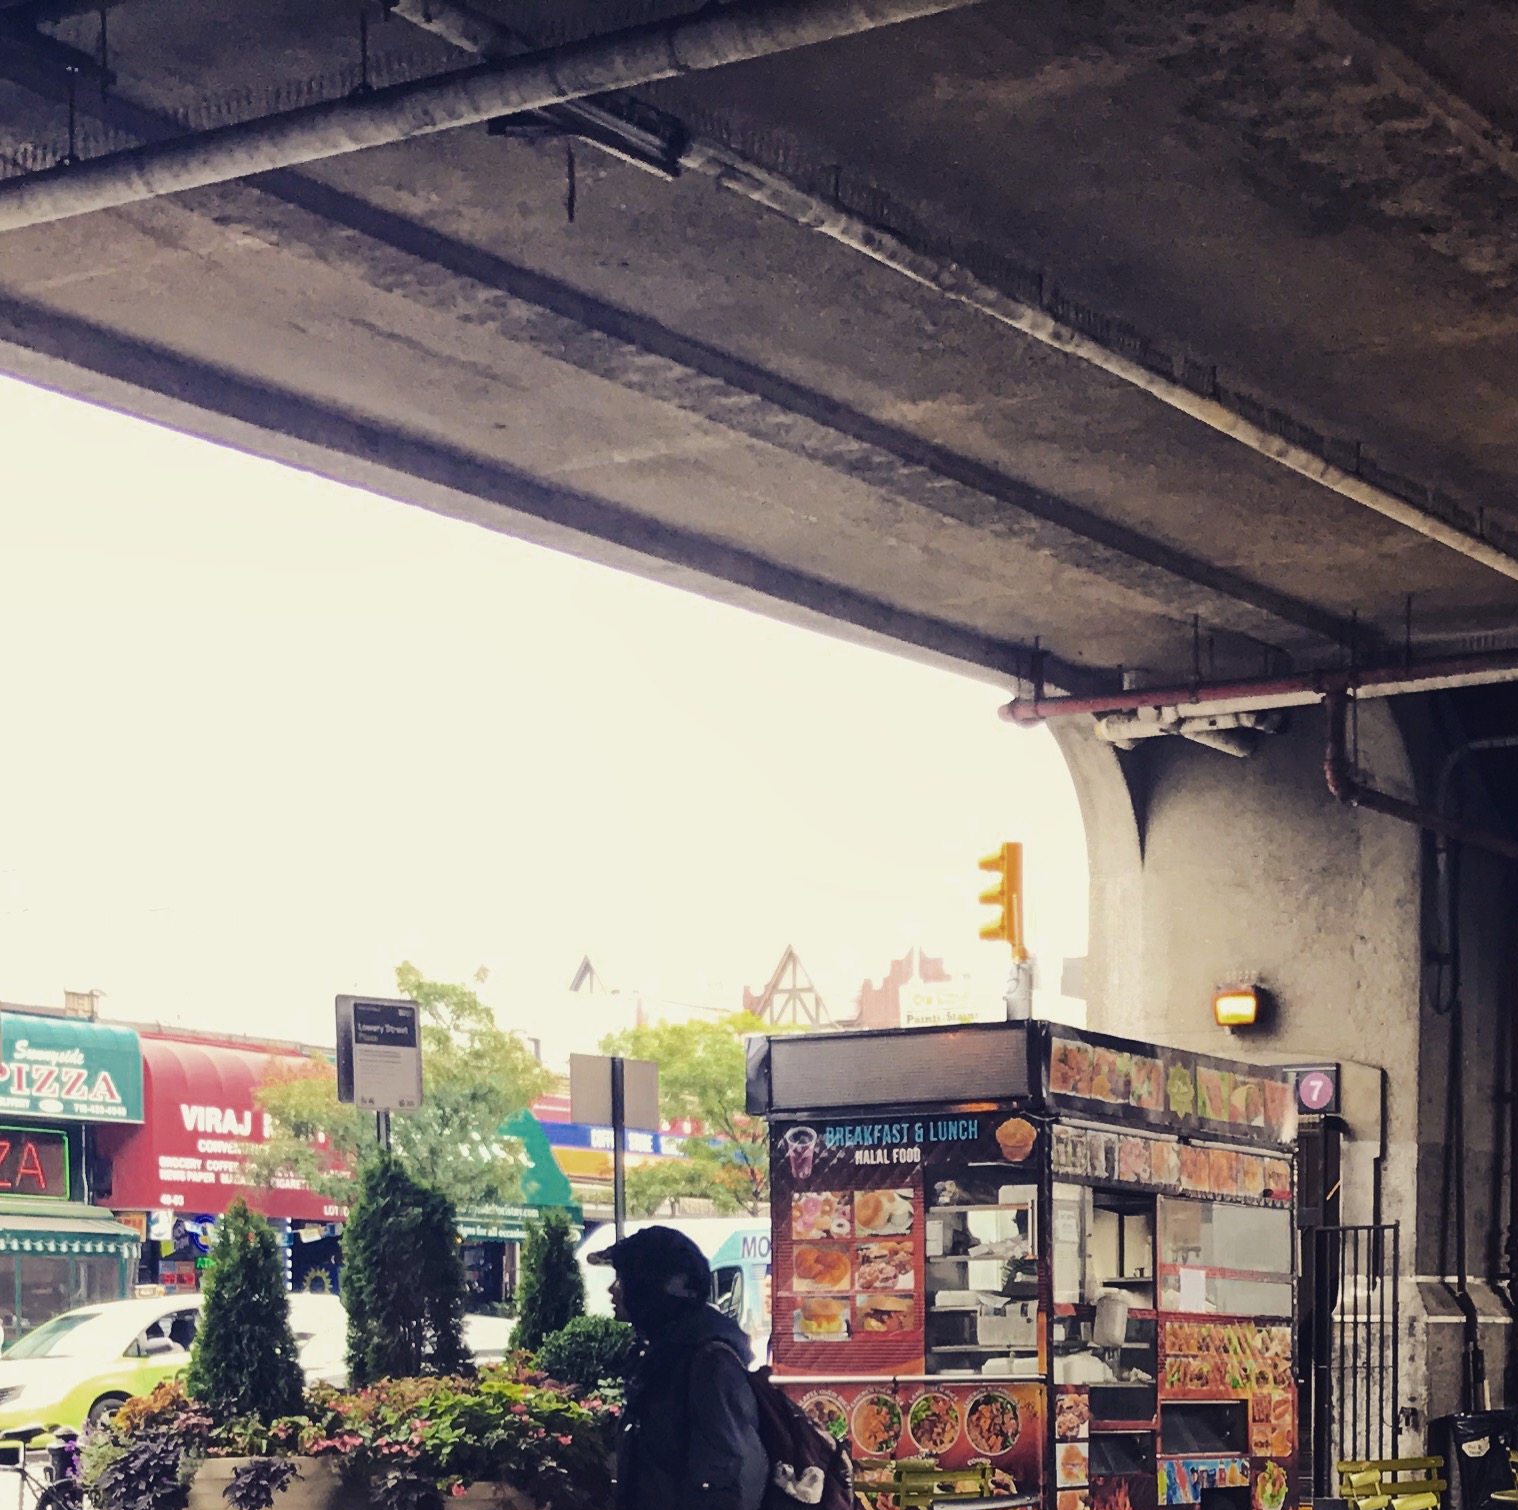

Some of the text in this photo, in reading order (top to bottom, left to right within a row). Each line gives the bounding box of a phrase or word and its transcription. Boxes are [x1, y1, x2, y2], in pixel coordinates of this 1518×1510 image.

[13, 1039, 85, 1066] Sunnyside
[1309, 1080, 1324, 1102] 7
[180, 1103, 252, 1137] VIRAJ
[824, 1119, 979, 1147] BREAKFAST & LUNCH
[855, 1147, 922, 1165] HALAL FOOD
[323, 1204, 350, 1217] LOTO
